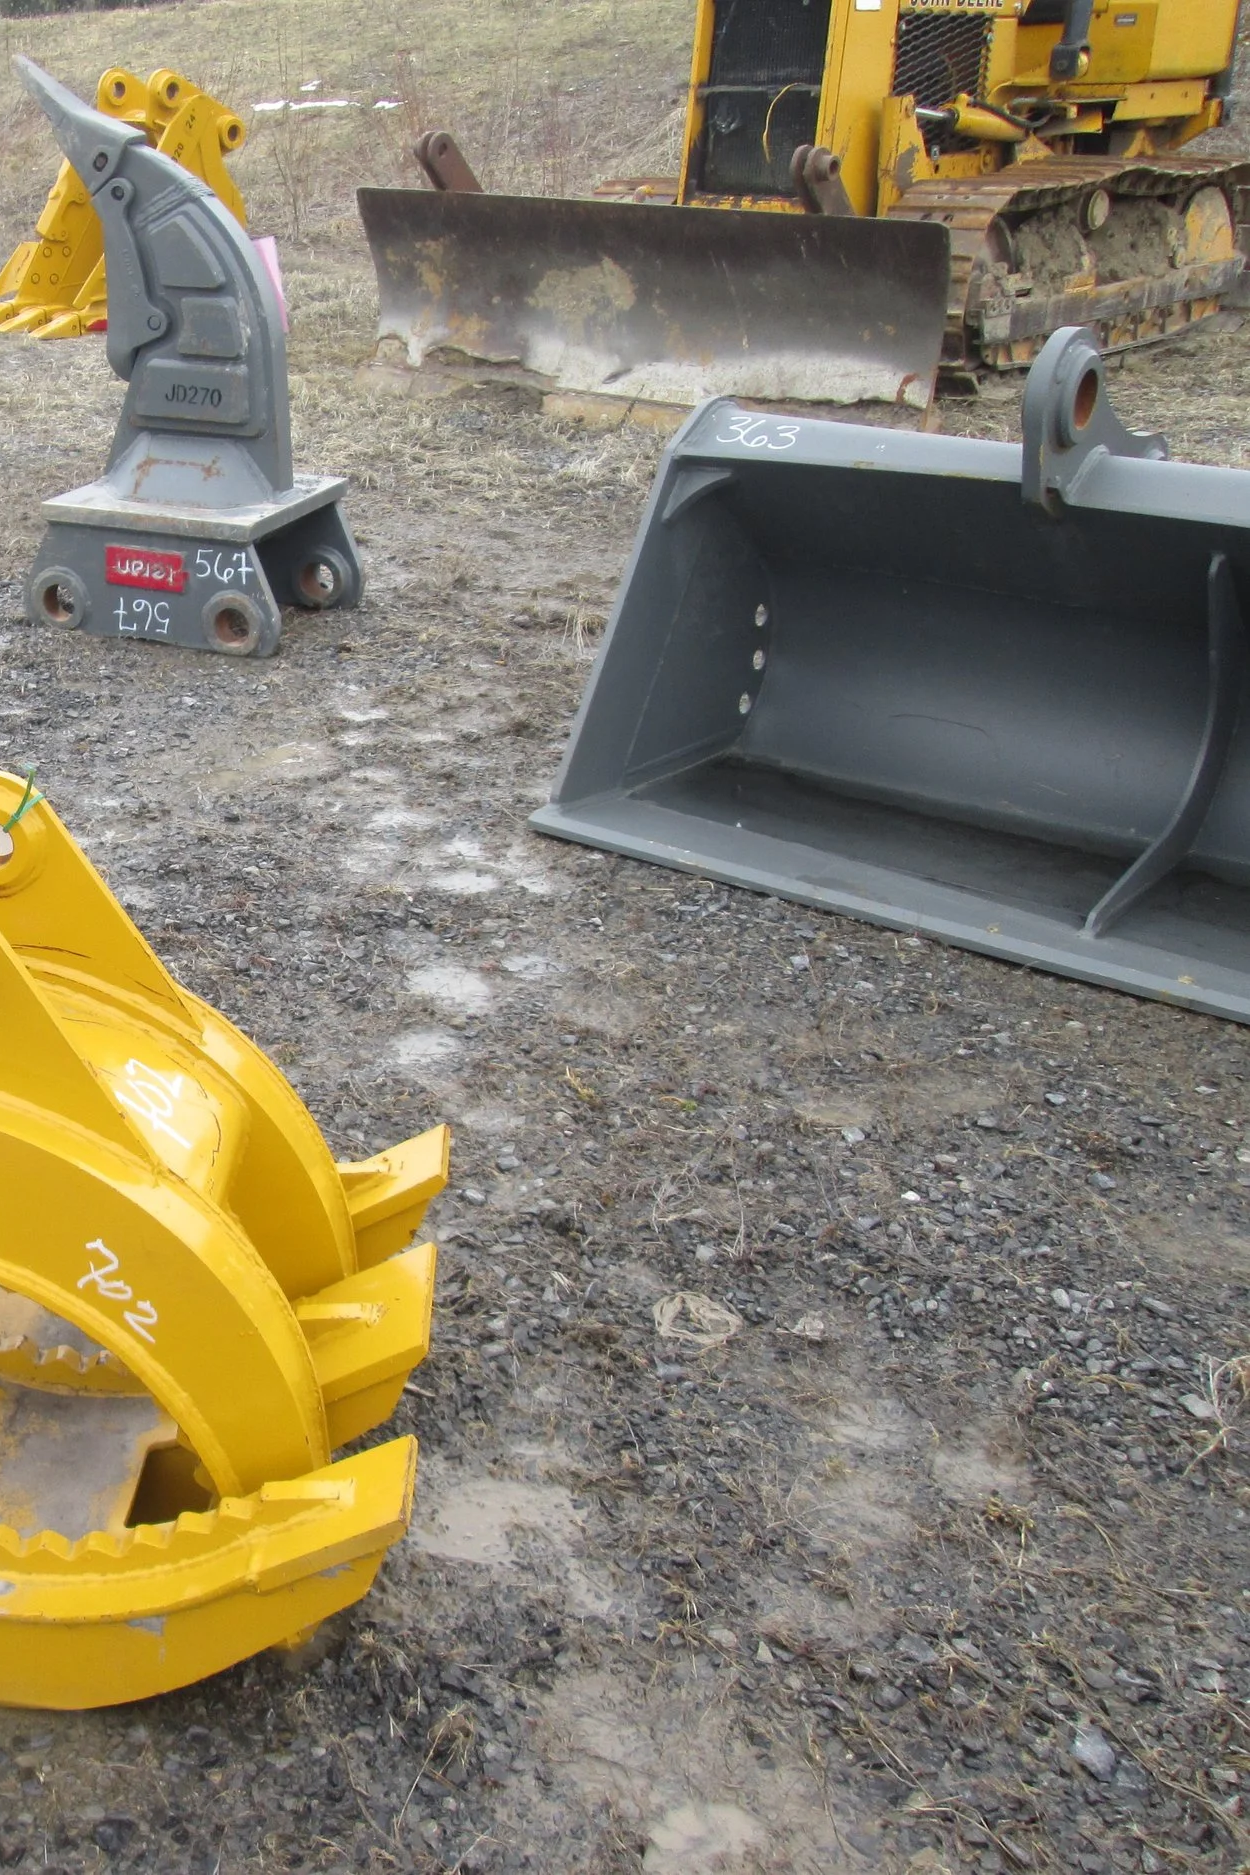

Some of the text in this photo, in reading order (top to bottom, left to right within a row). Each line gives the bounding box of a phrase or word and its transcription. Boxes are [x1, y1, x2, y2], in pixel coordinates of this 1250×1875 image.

[165, 383, 223, 409] JD270
[716, 415, 801, 451] 363
[115, 558, 177, 587] teran
[195, 548, 255, 585] 567
[112, 596, 171, 635] 567
[77, 1238, 159, 1344] 702
